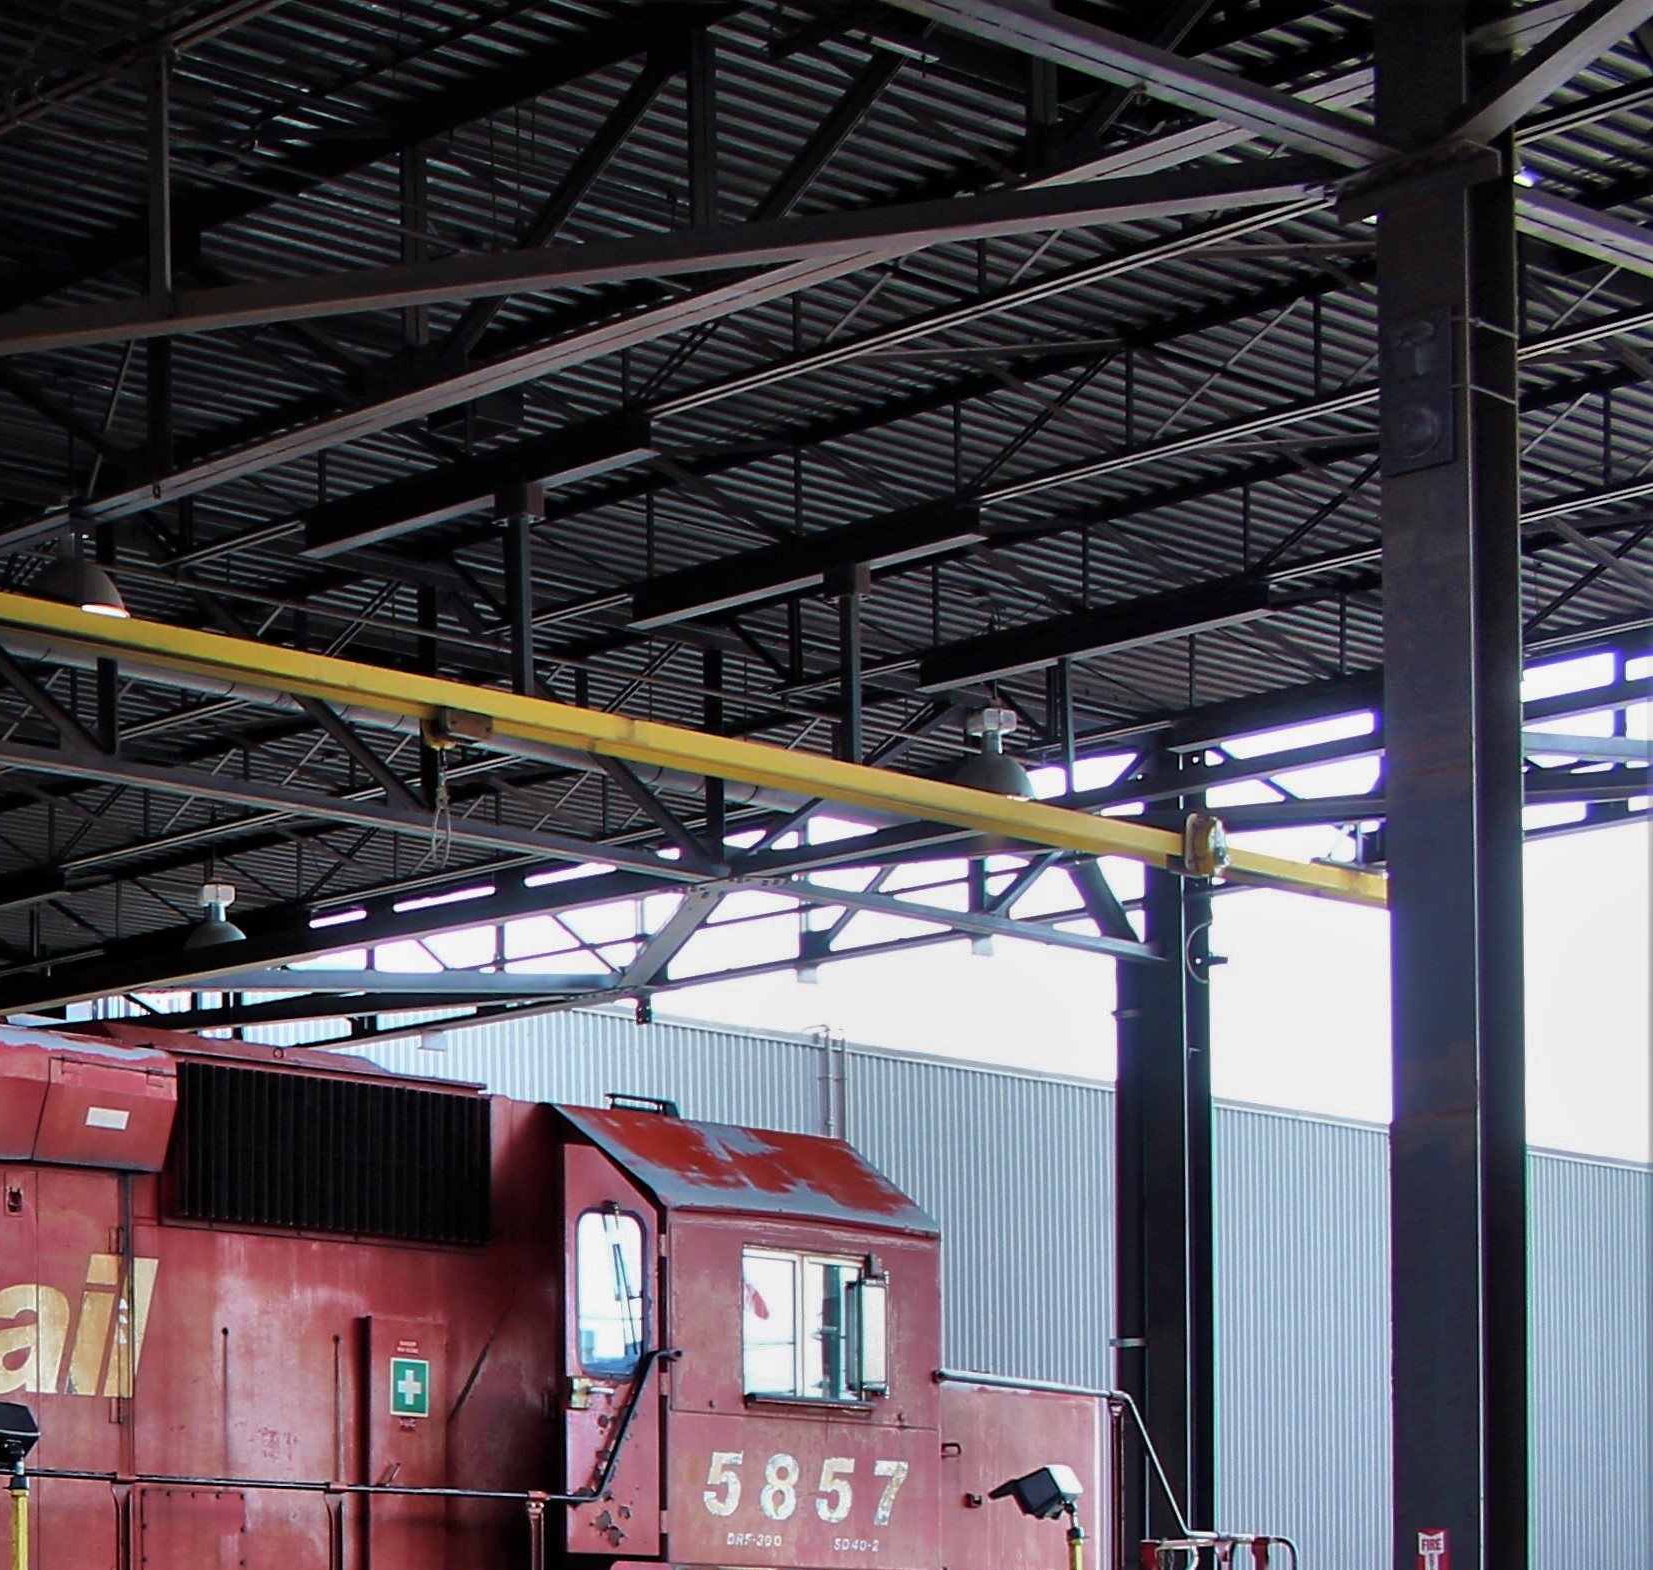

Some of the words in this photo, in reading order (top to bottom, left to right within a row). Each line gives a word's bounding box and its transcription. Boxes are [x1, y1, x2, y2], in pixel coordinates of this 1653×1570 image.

[703, 1450, 909, 1526] 5857
[726, 1531, 783, 1547] DRF-300
[832, 1537, 880, 1552] SD40-2
[1421, 1538, 1442, 1552] FIRE
